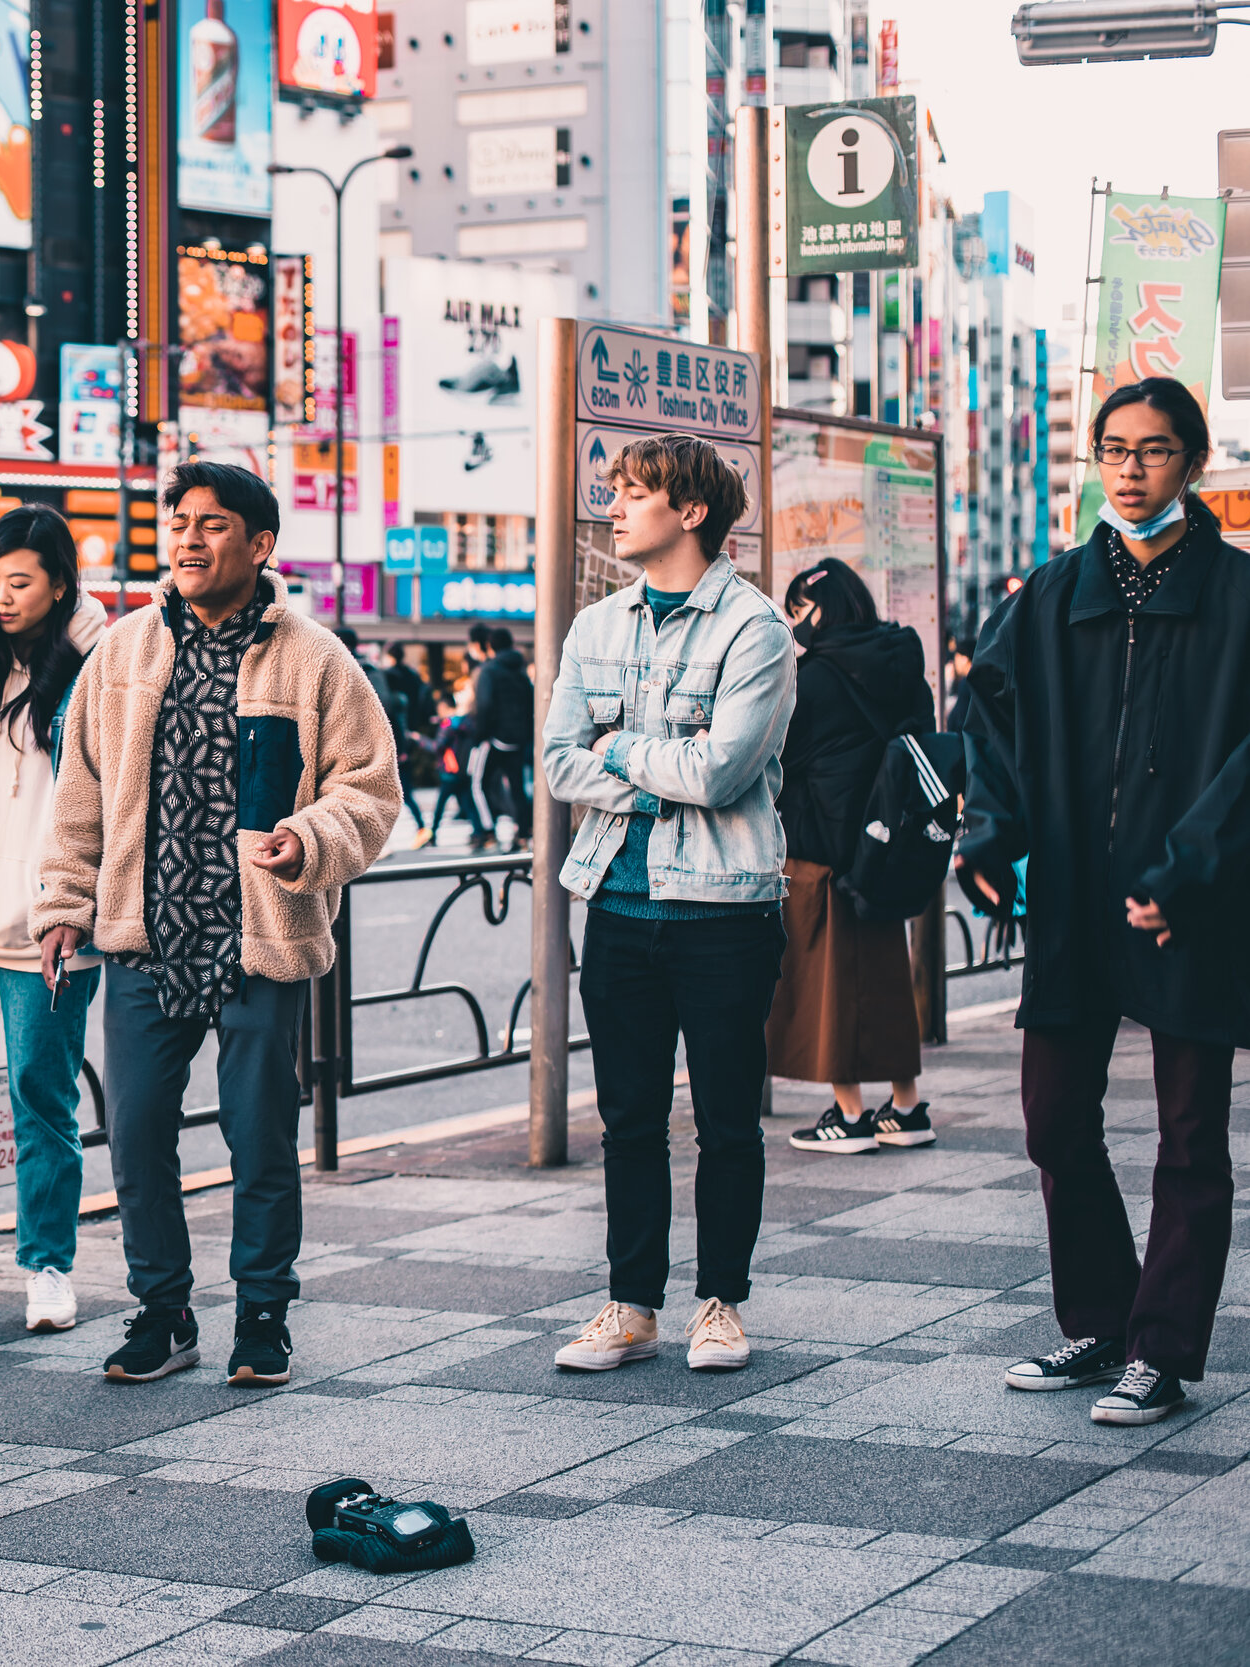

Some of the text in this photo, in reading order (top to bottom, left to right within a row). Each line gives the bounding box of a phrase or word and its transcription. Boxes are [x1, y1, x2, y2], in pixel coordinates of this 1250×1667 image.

[801, 219, 902, 243] 池袋案内地図
[800, 242, 840, 257] Ikebukuro
[840, 238, 886, 254] Information
[656, 350, 749, 399] 豊島区役所
[591, 385, 620, 409] 620m
[656, 390, 748, 428] Toshima City Office
